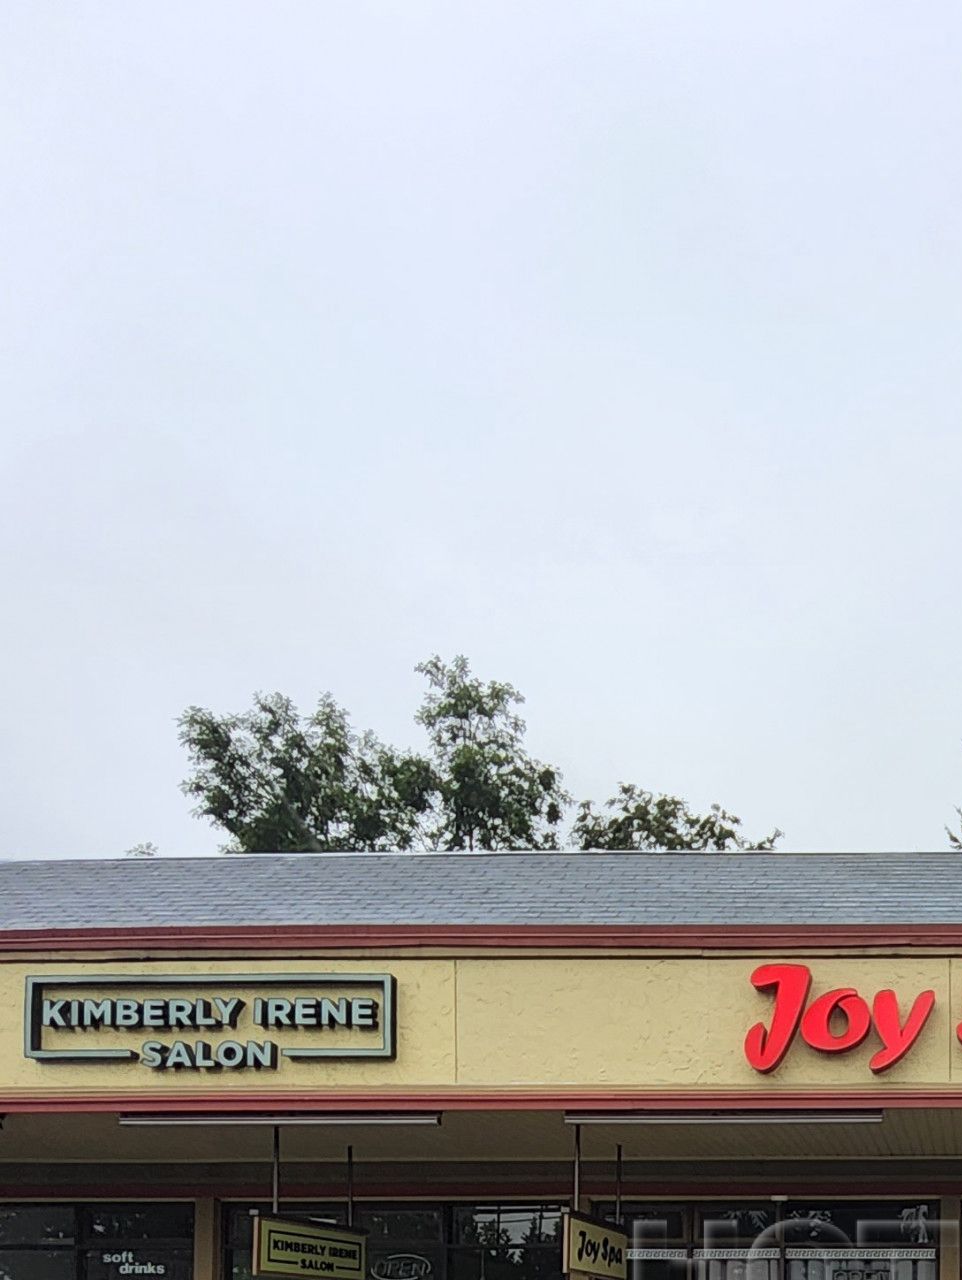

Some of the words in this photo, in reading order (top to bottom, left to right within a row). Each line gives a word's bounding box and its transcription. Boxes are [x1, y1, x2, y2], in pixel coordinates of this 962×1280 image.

[42, 997, 246, 1029] KIMBERLY
[253, 997, 376, 1028] IRENE
[744, 963, 936, 1074] Joy
[139, 1040, 276, 1070] SALON
[103, 1251, 134, 1263] soft
[273, 1239, 326, 1257] KIMBERLY
[328, 1249, 358, 1261] IRENE
[577, 1230, 600, 1264] Joy
[601, 1236, 623, 1268] Spa
[119, 1262, 165, 1274] drinks
[300, 1258, 335, 1272] SALON
[373, 1261, 427, 1276] OPEN
